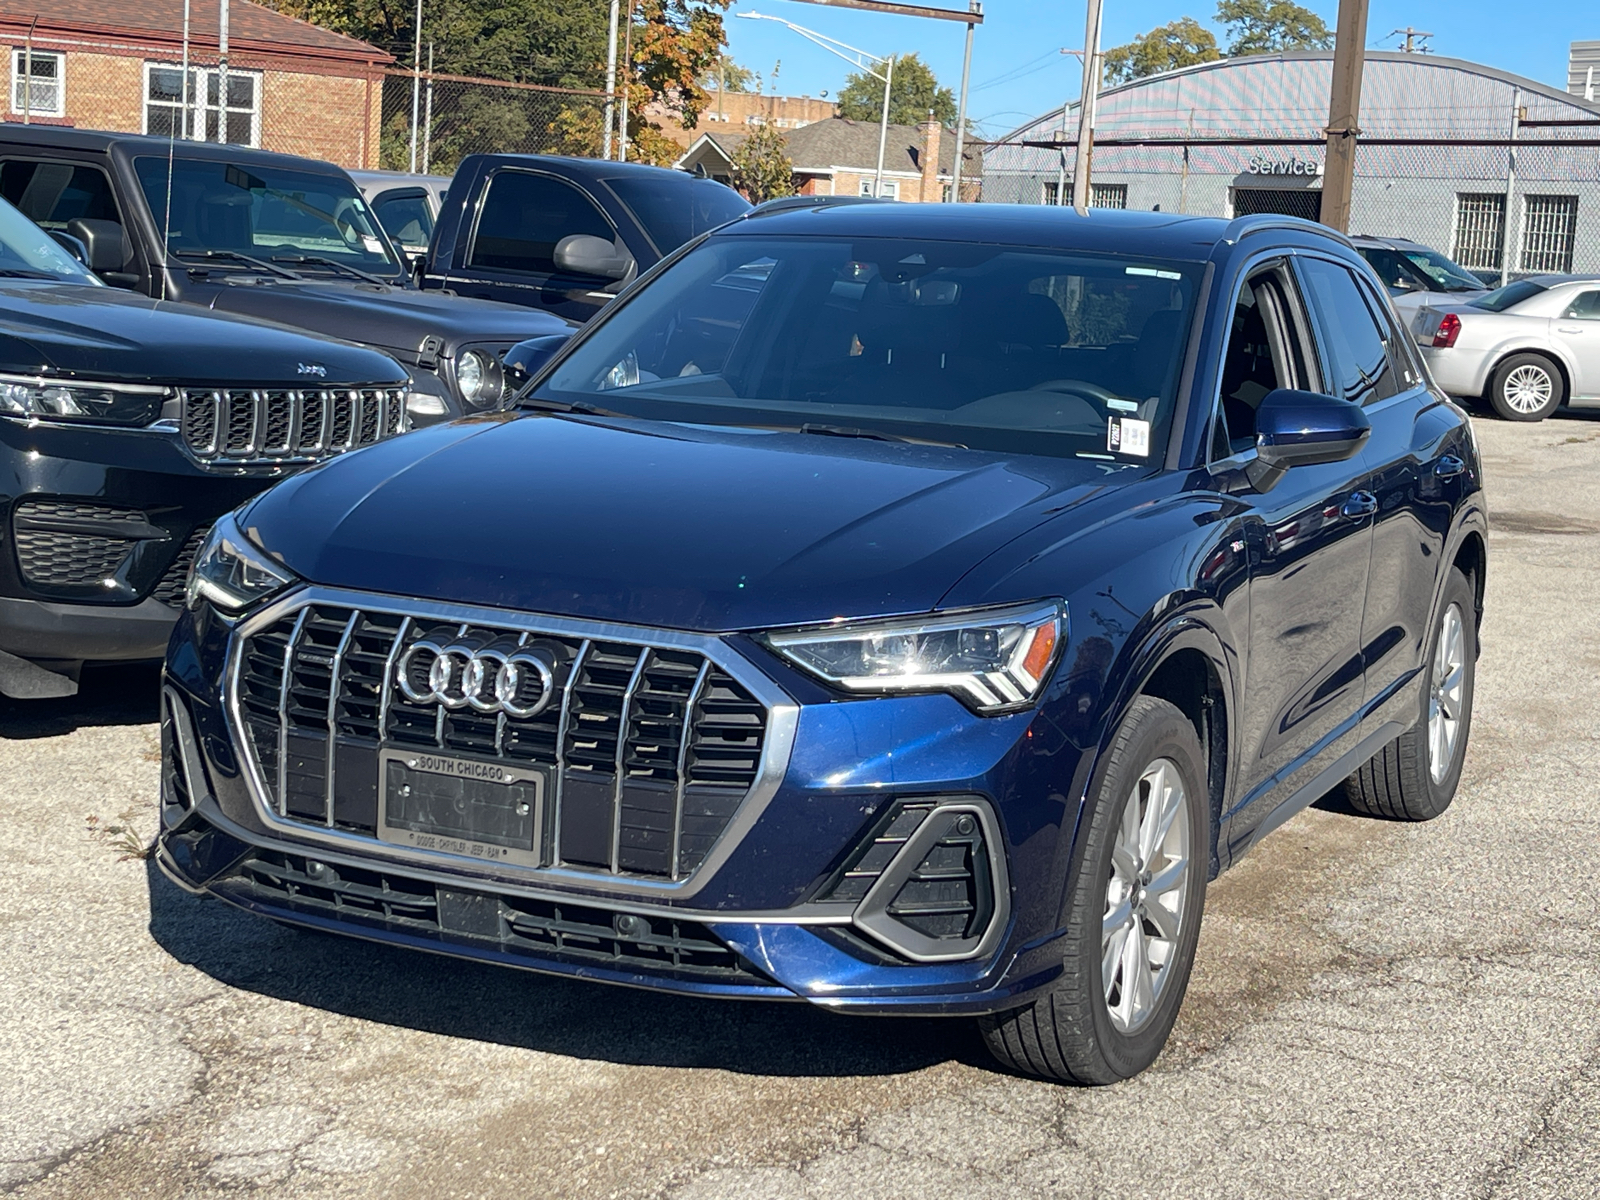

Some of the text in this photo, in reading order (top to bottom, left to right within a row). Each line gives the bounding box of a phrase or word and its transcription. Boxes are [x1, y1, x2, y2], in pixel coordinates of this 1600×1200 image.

[1249, 156, 1317, 176] Service
[419, 756, 503, 780] SOUTH CHICAGO
